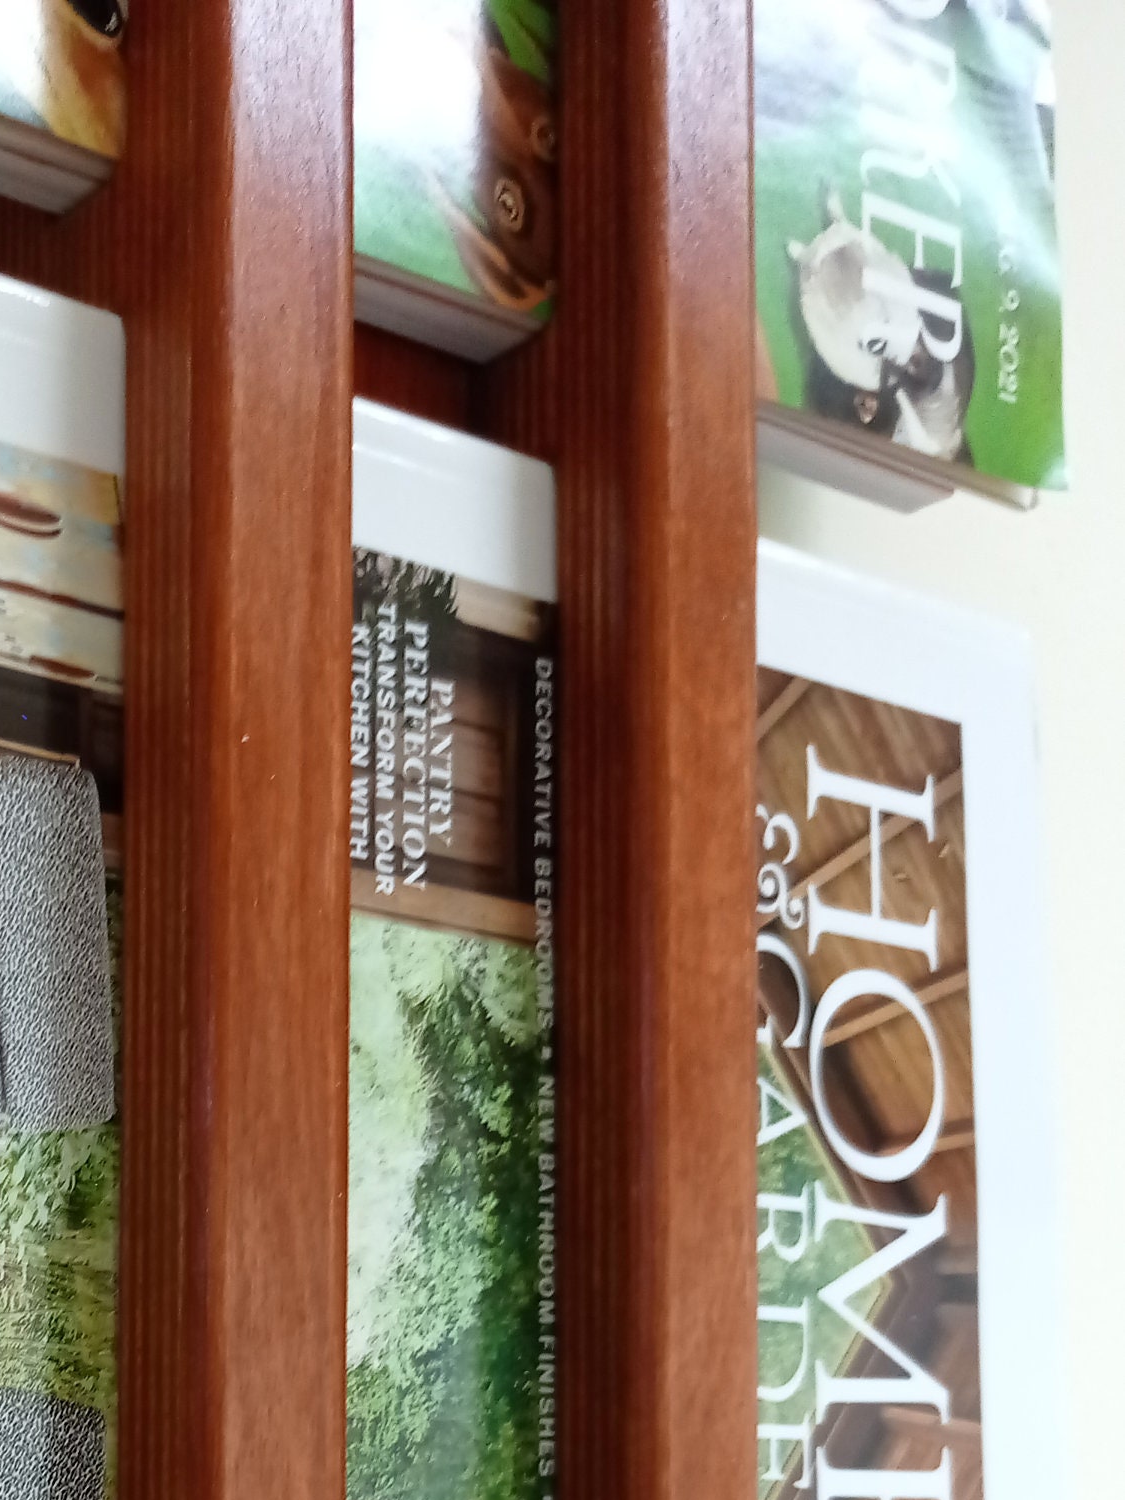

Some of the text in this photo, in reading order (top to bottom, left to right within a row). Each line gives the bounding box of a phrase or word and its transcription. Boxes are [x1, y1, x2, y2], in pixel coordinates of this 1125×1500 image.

[998, 323, 1020, 404] 2021
[350, 623, 370, 861] KITCHEN WITH
[375, 602, 397, 896] TRANSFORM YOUR
[402, 619, 429, 891] PERFECTION
[428, 678, 455, 847] PANTRY
[534, 657, 555, 848] DECORATIVE
[534, 857, 555, 1030] BEDROOMS
[537, 1076, 556, 1143] NEW
[537, 1153, 556, 1328] BATHROOM
[538, 1335, 557, 1478] FINISHES
